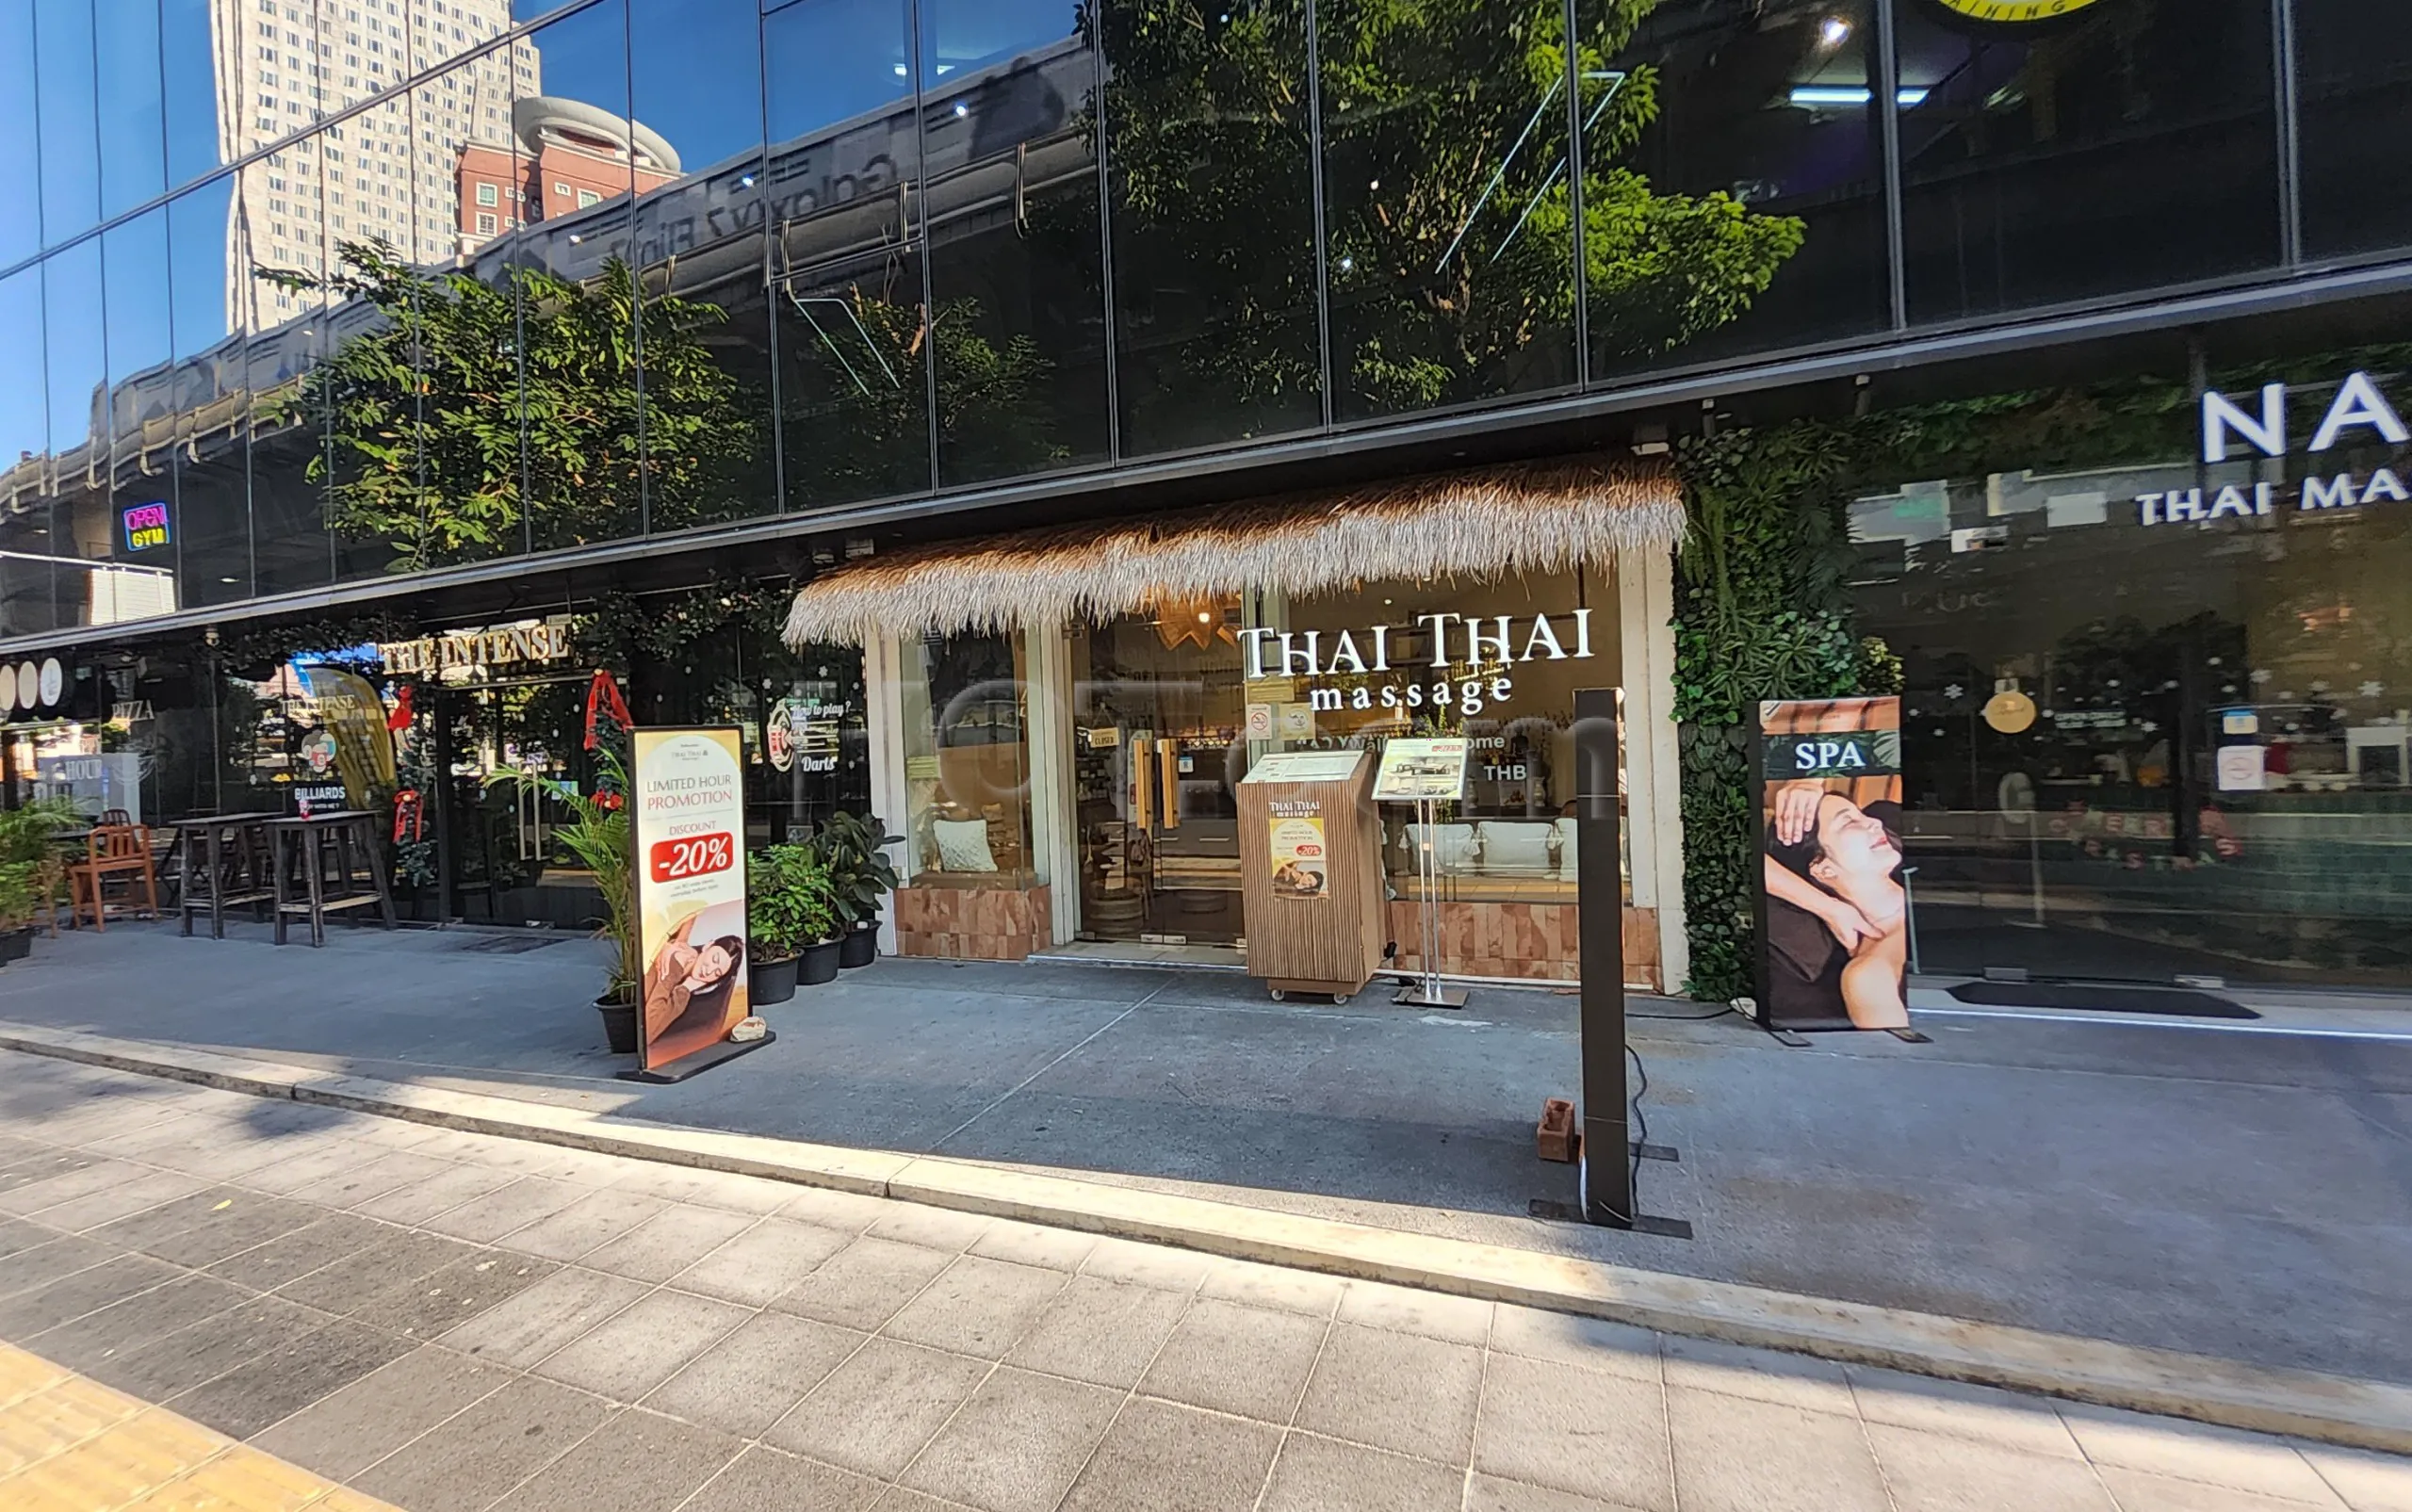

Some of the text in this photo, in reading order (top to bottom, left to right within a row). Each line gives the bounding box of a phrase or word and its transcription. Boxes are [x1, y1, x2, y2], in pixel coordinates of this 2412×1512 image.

[1948, 0, 2066, 20] AINING
[2135, 480, 2272, 526] THAI
[127, 506, 165, 530] OPEN
[133, 528, 164, 547] GYM
[379, 624, 572, 675] THE INTENSE
[1236, 608, 1595, 679] THAI THAI
[1311, 675, 1513, 716] massage
[111, 699, 155, 723] PIZZA
[790, 704, 811, 717] How
[813, 706, 823, 716] to
[823, 703, 844, 718] play
[1094, 736, 1115, 745] CLOSED
[801, 756, 837, 772] Darts
[1795, 740, 1866, 770] SPA
[1484, 764, 1527, 781] THB
[646, 774, 732, 793] LIMITED HOUR
[294, 786, 346, 801] BILLIARDS
[647, 789, 733, 811] PROMOTION
[1269, 801, 1320, 811] THAI THAI
[669, 821, 717, 836] DISCOUNT
[659, 836, 729, 877] -20%
[1297, 847, 1320, 855] -20%
